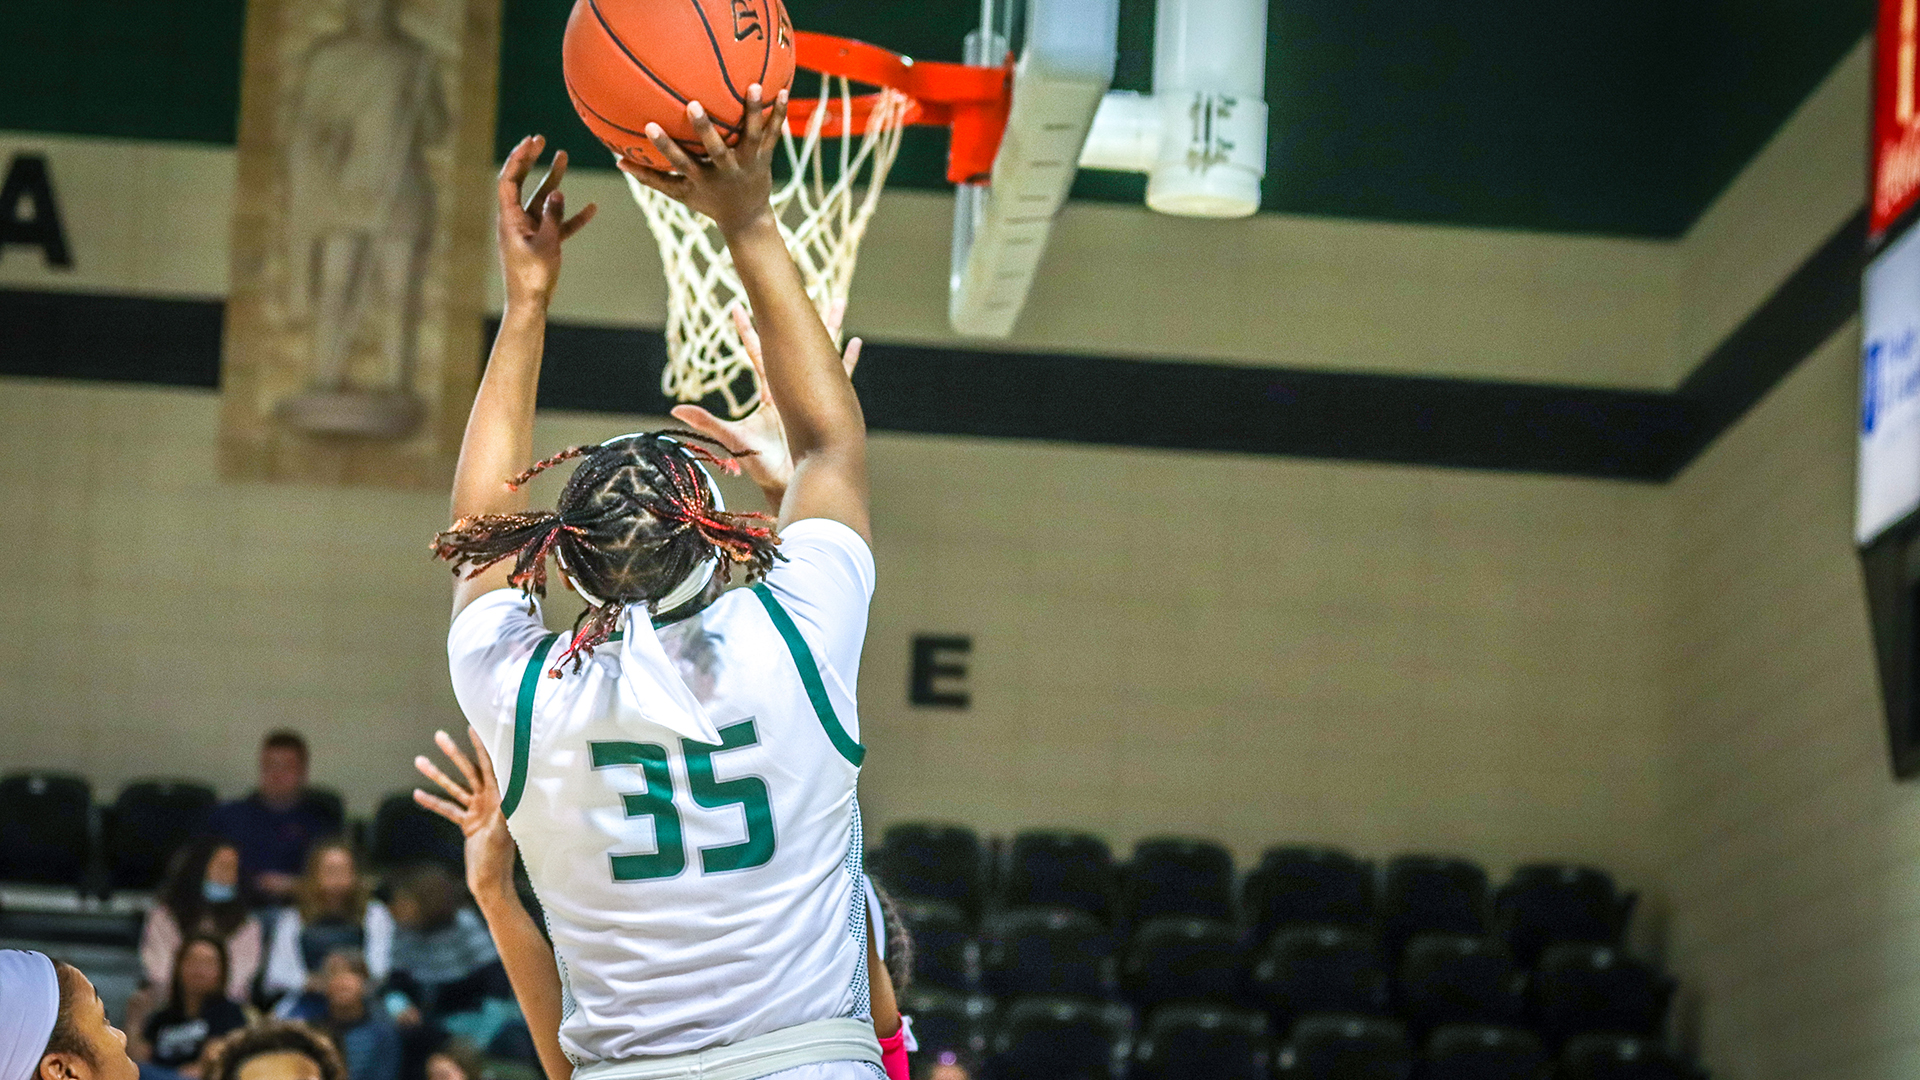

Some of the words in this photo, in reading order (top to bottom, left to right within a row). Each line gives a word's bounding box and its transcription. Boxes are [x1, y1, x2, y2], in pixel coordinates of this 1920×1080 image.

[0, 155, 74, 270] A
[908, 634, 972, 709] E
[587, 716, 778, 884] 35
